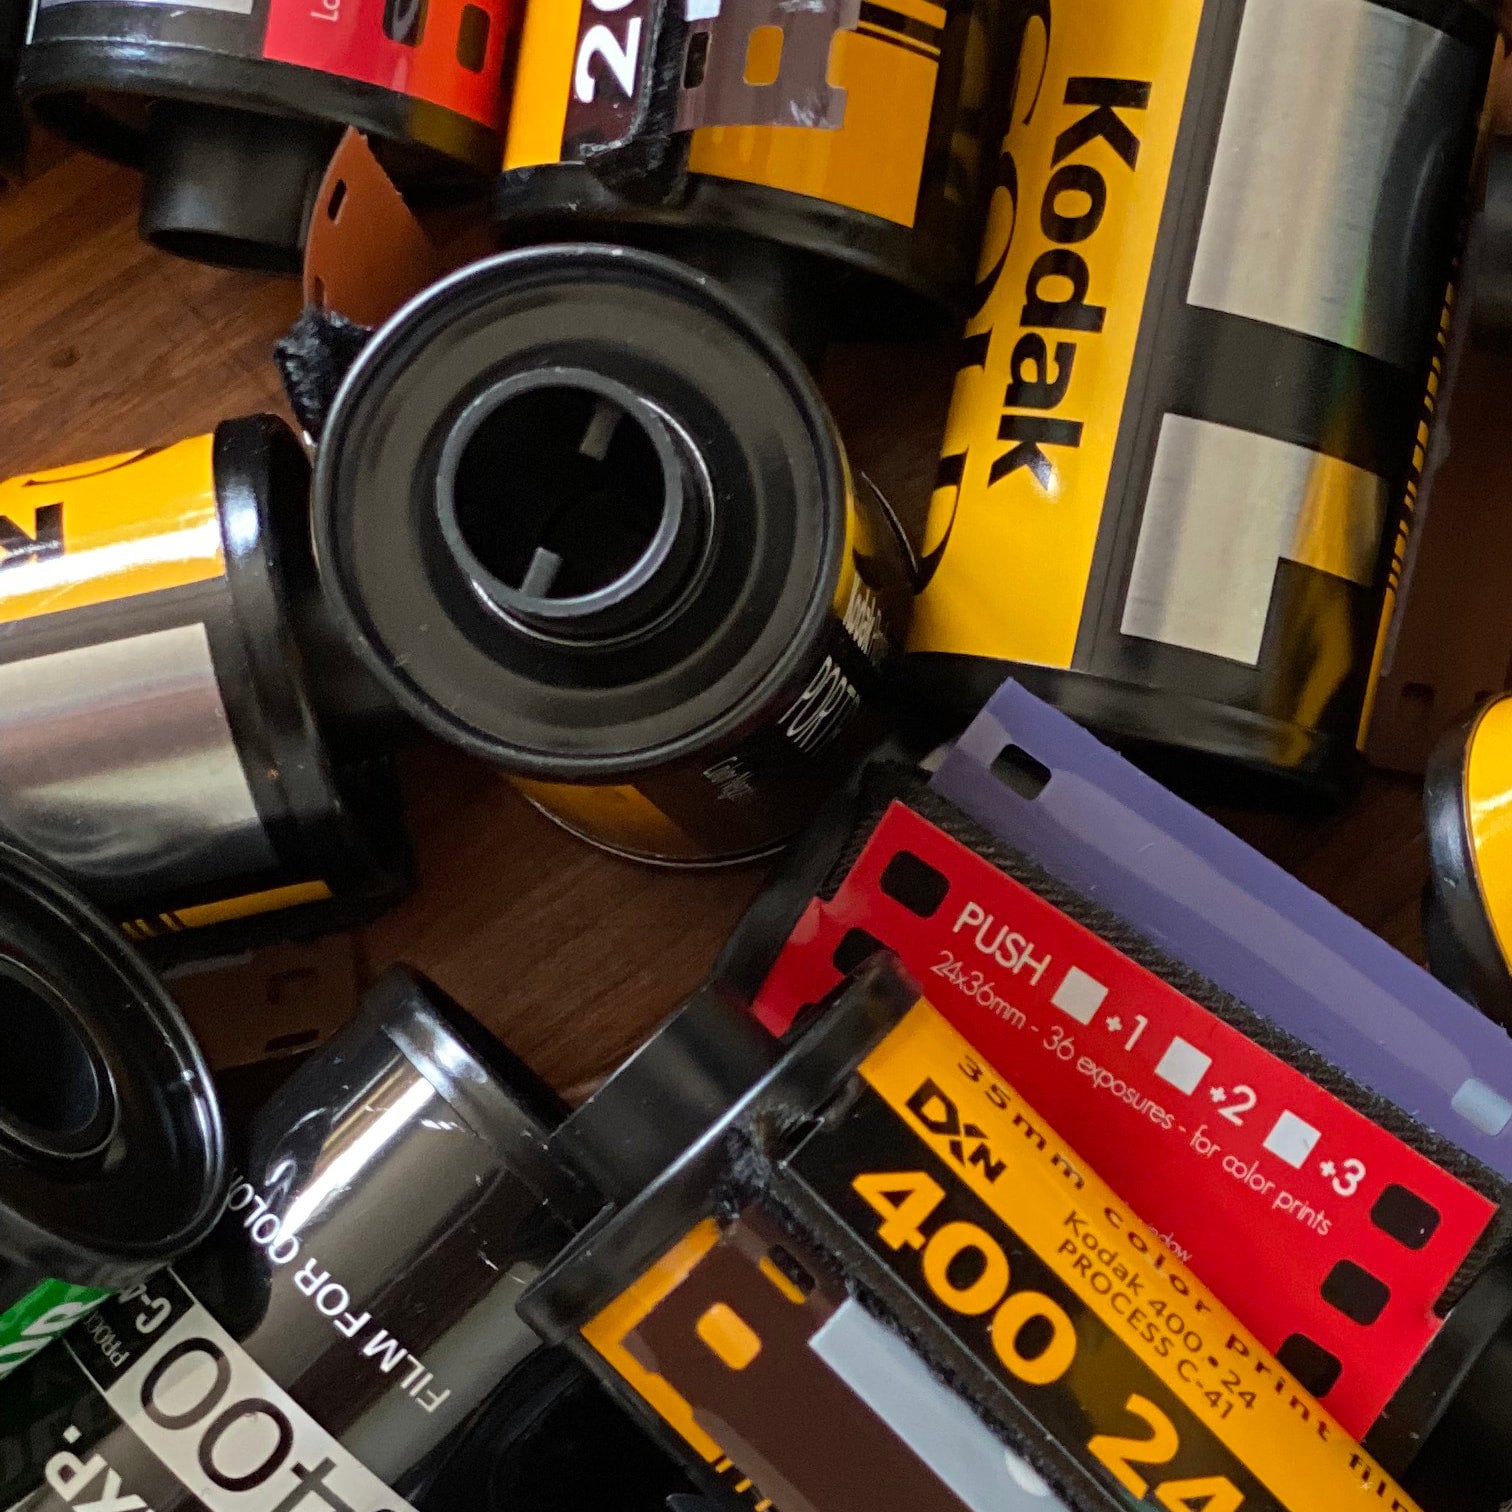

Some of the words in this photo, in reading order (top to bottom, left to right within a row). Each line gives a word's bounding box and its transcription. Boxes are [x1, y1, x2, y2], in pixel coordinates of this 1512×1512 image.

[575, 0, 642, 103] 2
[988, 77, 1152, 490] Kodak
[952, 901, 1052, 986] PUSH
[929, 950, 1027, 1030] 24x36mm
[1043, 1025, 1075, 1061] 36
[1075, 1056, 1175, 1131] exposures
[1190, 1124, 1221, 1158] for
[1222, 1154, 1275, 1196] color
[1272, 1190, 1333, 1237] prints
[294, 1258, 372, 1338] FOR
[362, 1329, 451, 1413] FILM
[851, 1171, 1077, 1386] 400
[1057, 1238, 1179, 1358] PROCESS
[1176, 1359, 1233, 1420] C-41
[1063, 1210, 1145, 1297] Kodak
[1150, 1298, 1204, 1355] 400
[1220, 1370, 1258, 1410] 24
[1104, 1206, 1212, 1314] color
[1225, 1333, 1332, 1443] print
